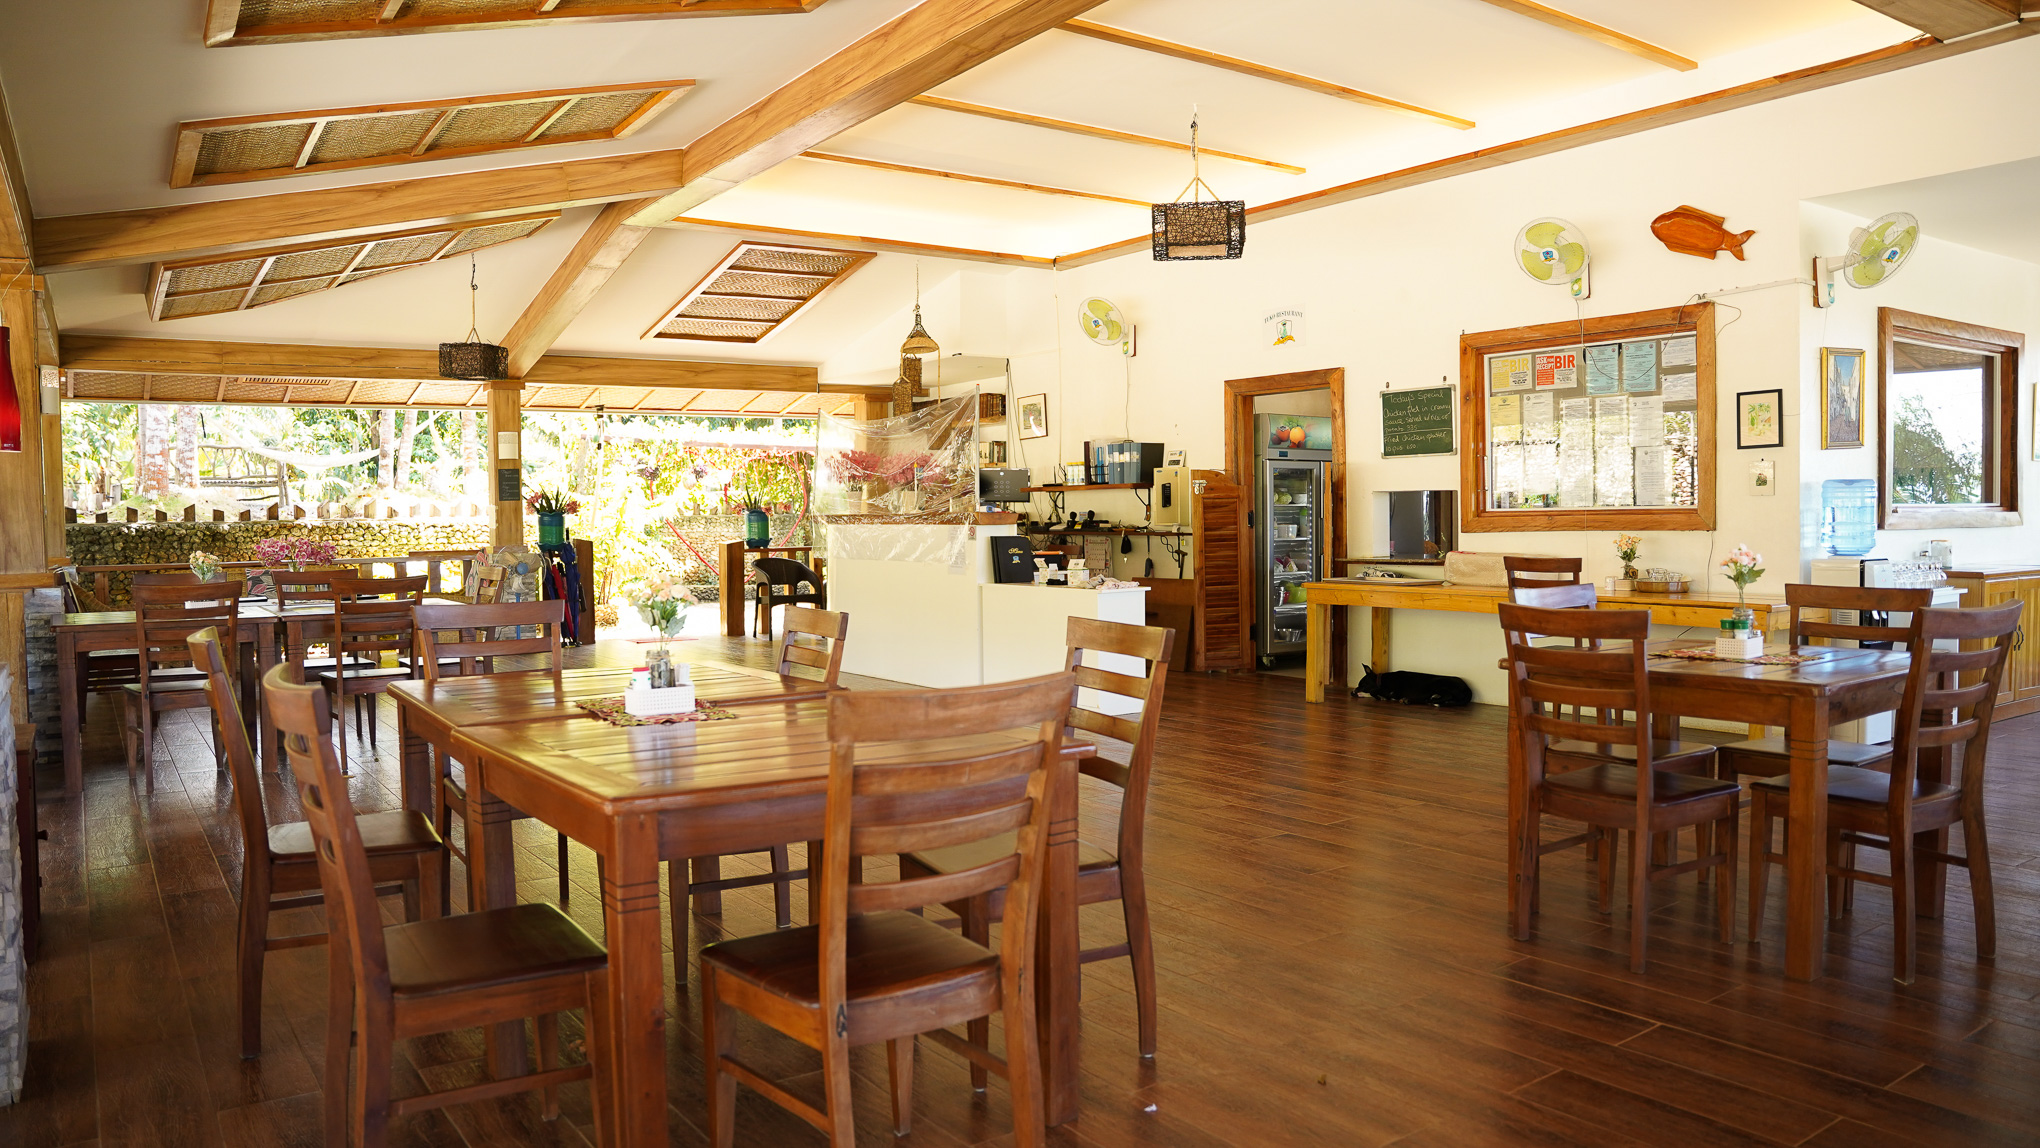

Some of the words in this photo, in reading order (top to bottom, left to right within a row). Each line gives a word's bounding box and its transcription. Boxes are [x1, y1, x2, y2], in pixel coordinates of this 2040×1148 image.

[1510, 358, 1530, 373] BIR
[1554, 355, 1576, 369] BIR
[1385, 393, 1415, 404] Today's
[1418, 390, 1444, 403] Special
